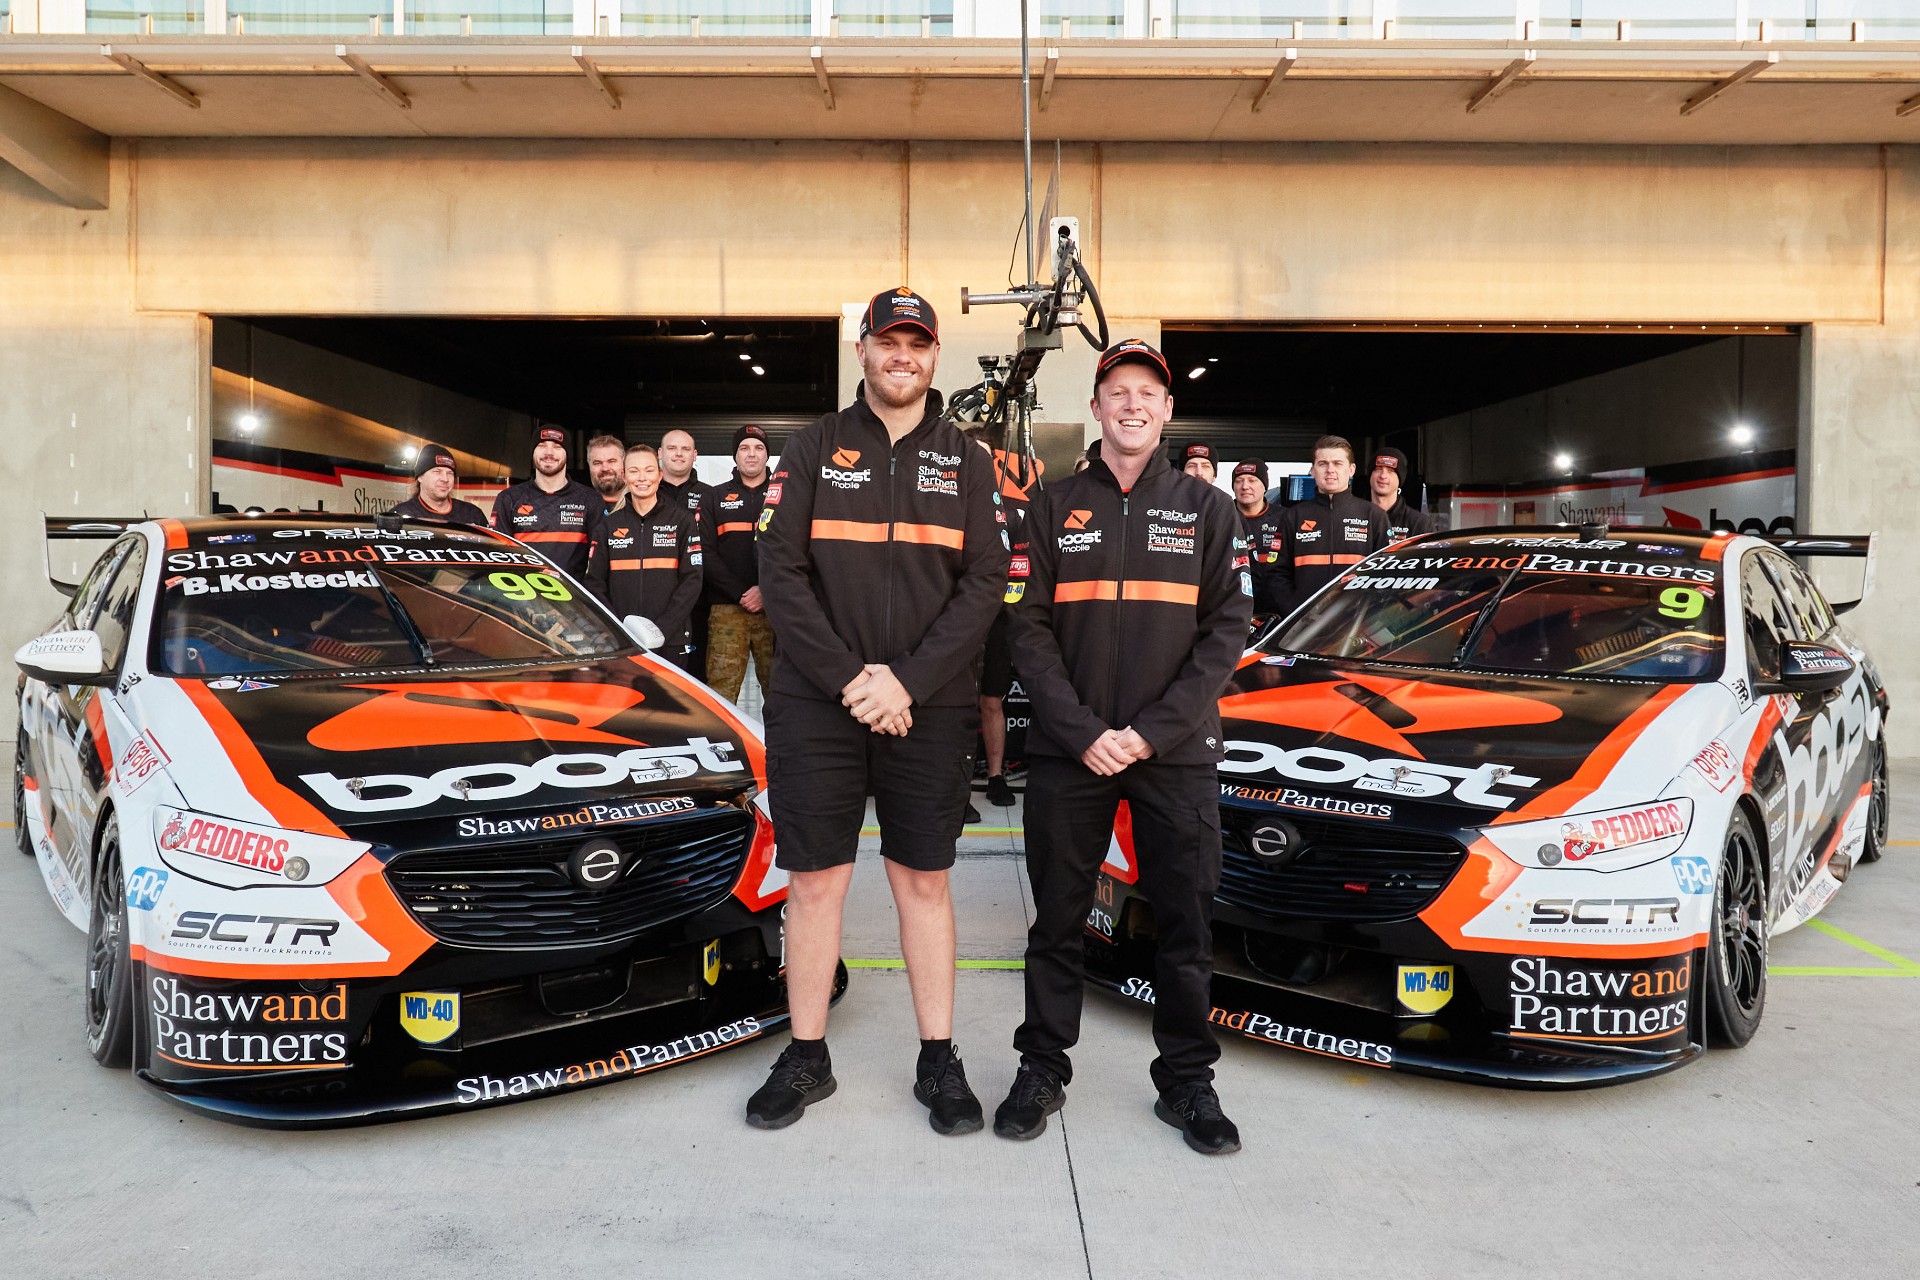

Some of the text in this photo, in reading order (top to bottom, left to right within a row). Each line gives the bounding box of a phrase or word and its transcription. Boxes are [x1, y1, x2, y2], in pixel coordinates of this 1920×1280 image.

[821, 466, 871, 482] boost
[831, 480, 860, 489] mobile
[513, 514, 538, 523] boost
[1146, 509, 1198, 520] erebus
[608, 537, 634, 545] boost
[1147, 533, 1195, 547] Partners
[1148, 523, 1195, 536] Shawand
[1295, 530, 1322, 540] boost
[167, 544, 545, 572] ShawandPartners
[1062, 544, 1091, 553] mobile
[1010, 562, 1027, 571] rays
[1356, 553, 1715, 582] ShawandPartners
[183, 570, 380, 596] B.Kostecki
[488, 572, 573, 602] 99
[1343, 575, 1440, 590] Brown
[1658, 587, 1705, 619] 9
[298, 737, 744, 813] boost
[1217, 741, 1541, 809] oost
[1219, 783, 1392, 817] wandPartners
[458, 795, 695, 837] ShawandPartners
[1592, 803, 1684, 850] PEDDERS
[182, 818, 289, 872] PEDDERS
[126, 871, 165, 906] PPG
[1673, 859, 1712, 892] PPG
[1529, 898, 1681, 925] SCTR
[170, 910, 340, 947] SCTR
[1527, 926, 1681, 934] SouthernCrossTruckRentals
[167, 939, 333, 956] SouthernCrossTruckRentals
[1404, 970, 1451, 993] WD-40
[1510, 955, 1691, 997] Shawand
[152, 976, 347, 1022] Shawand
[405, 996, 454, 1023] WD-40
[1510, 993, 1688, 1035] Partners
[153, 1012, 347, 1063] Partners
[456, 1016, 761, 1104] ShawandPartners
